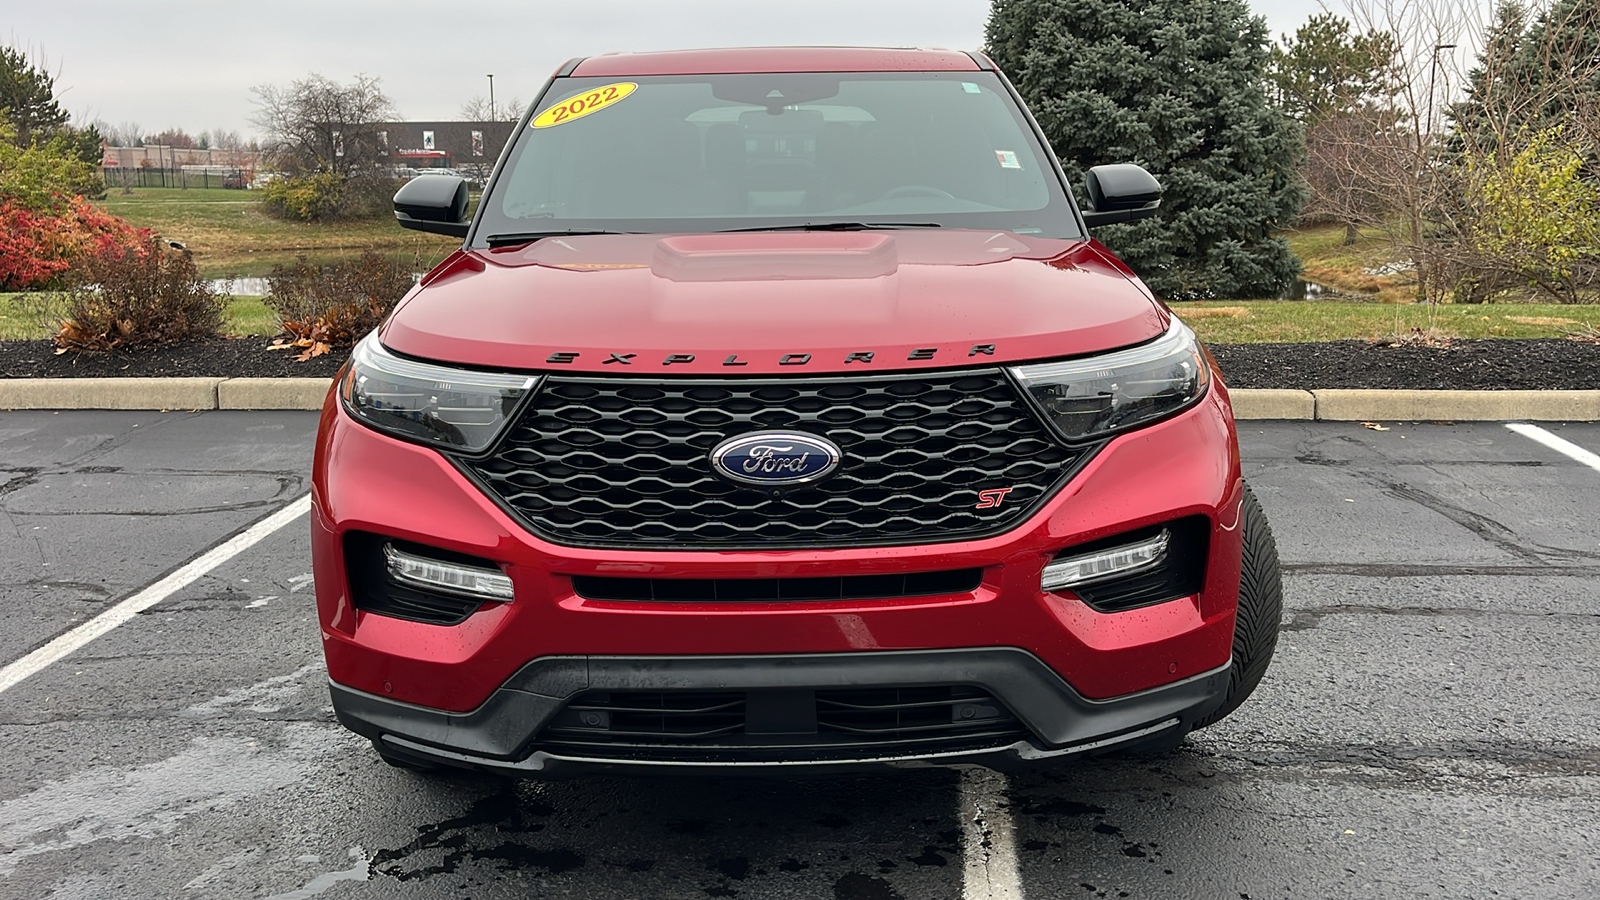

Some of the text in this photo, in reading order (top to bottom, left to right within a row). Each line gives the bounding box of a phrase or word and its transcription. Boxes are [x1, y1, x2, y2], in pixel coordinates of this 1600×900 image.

[552, 87, 619, 123] 2022
[546, 343, 996, 366] EXPLORER
[742, 445, 810, 473] Ford
[975, 487, 1013, 509] ST
